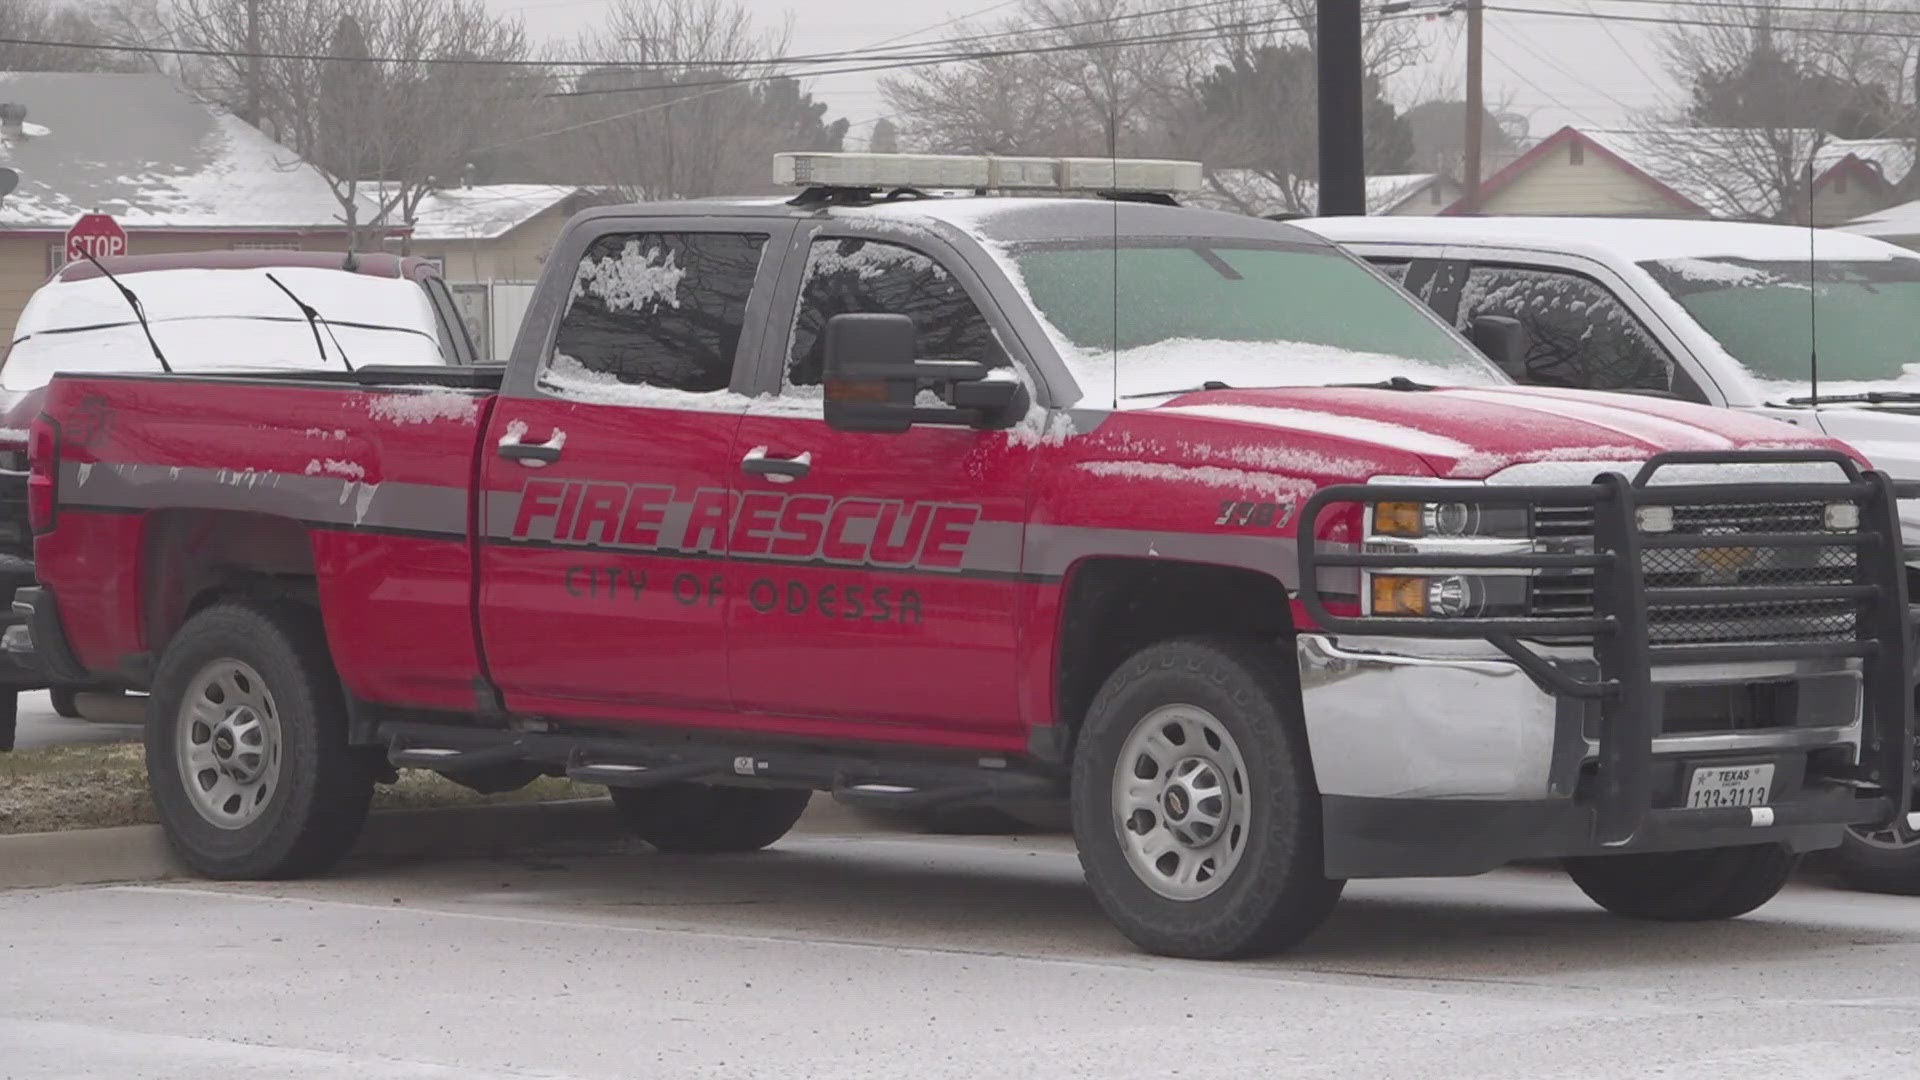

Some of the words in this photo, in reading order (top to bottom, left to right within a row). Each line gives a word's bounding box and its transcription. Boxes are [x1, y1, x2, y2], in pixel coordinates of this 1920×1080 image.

[69, 234, 123, 261] STOP
[512, 478, 675, 550] FIRE
[680, 488, 981, 571] RESCUE
[564, 565, 648, 602] CITY
[672, 573, 724, 607] OF
[748, 577, 923, 625] ODESSA
[1718, 769, 1751, 782] TEXAS
